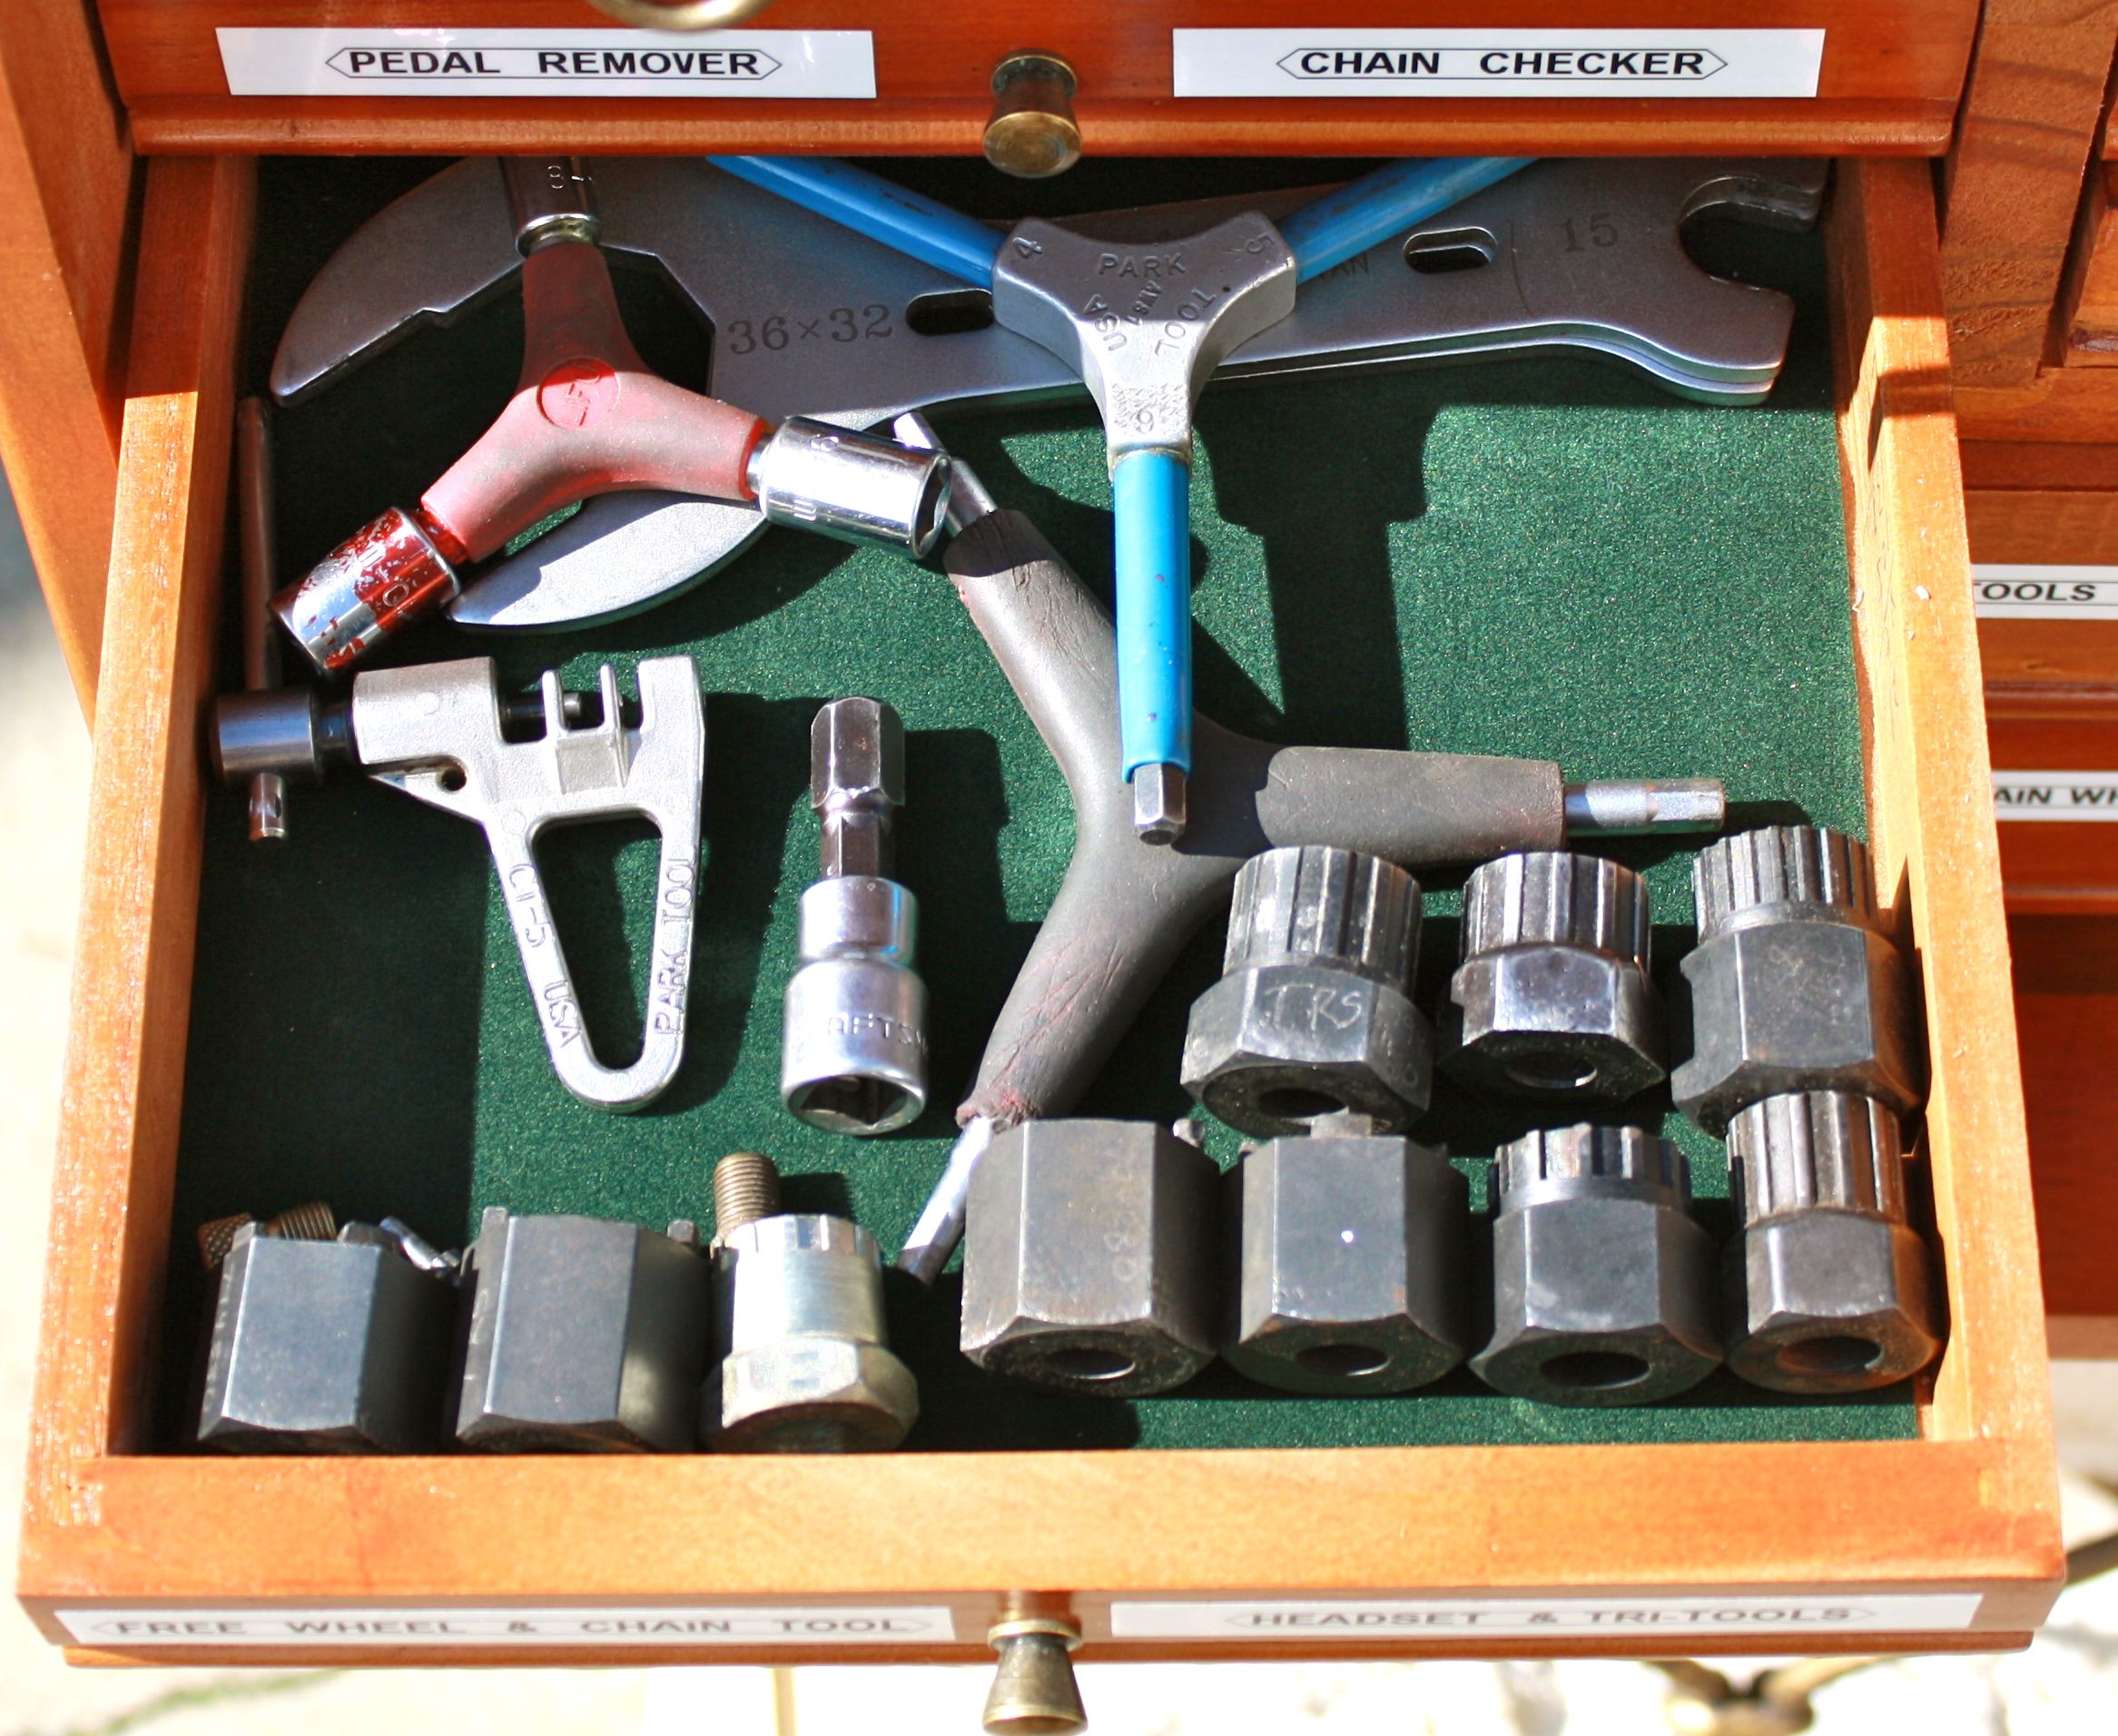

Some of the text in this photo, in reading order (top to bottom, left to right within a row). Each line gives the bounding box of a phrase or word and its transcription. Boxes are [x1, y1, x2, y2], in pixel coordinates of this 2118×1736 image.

[350, 51, 760, 75] PEDAL REMOVER
[1299, 51, 1705, 75] CHAIN CHECKER
[1560, 212, 1620, 253] 15
[1098, 252, 1187, 278] PARK
[1973, 582, 2097, 602] OOLS
[116, 1619, 910, 1633] FREE WHEEL & CHAIN TOOL
[1251, 1608, 1851, 1625] HEADSET & TRI-TOOLS
